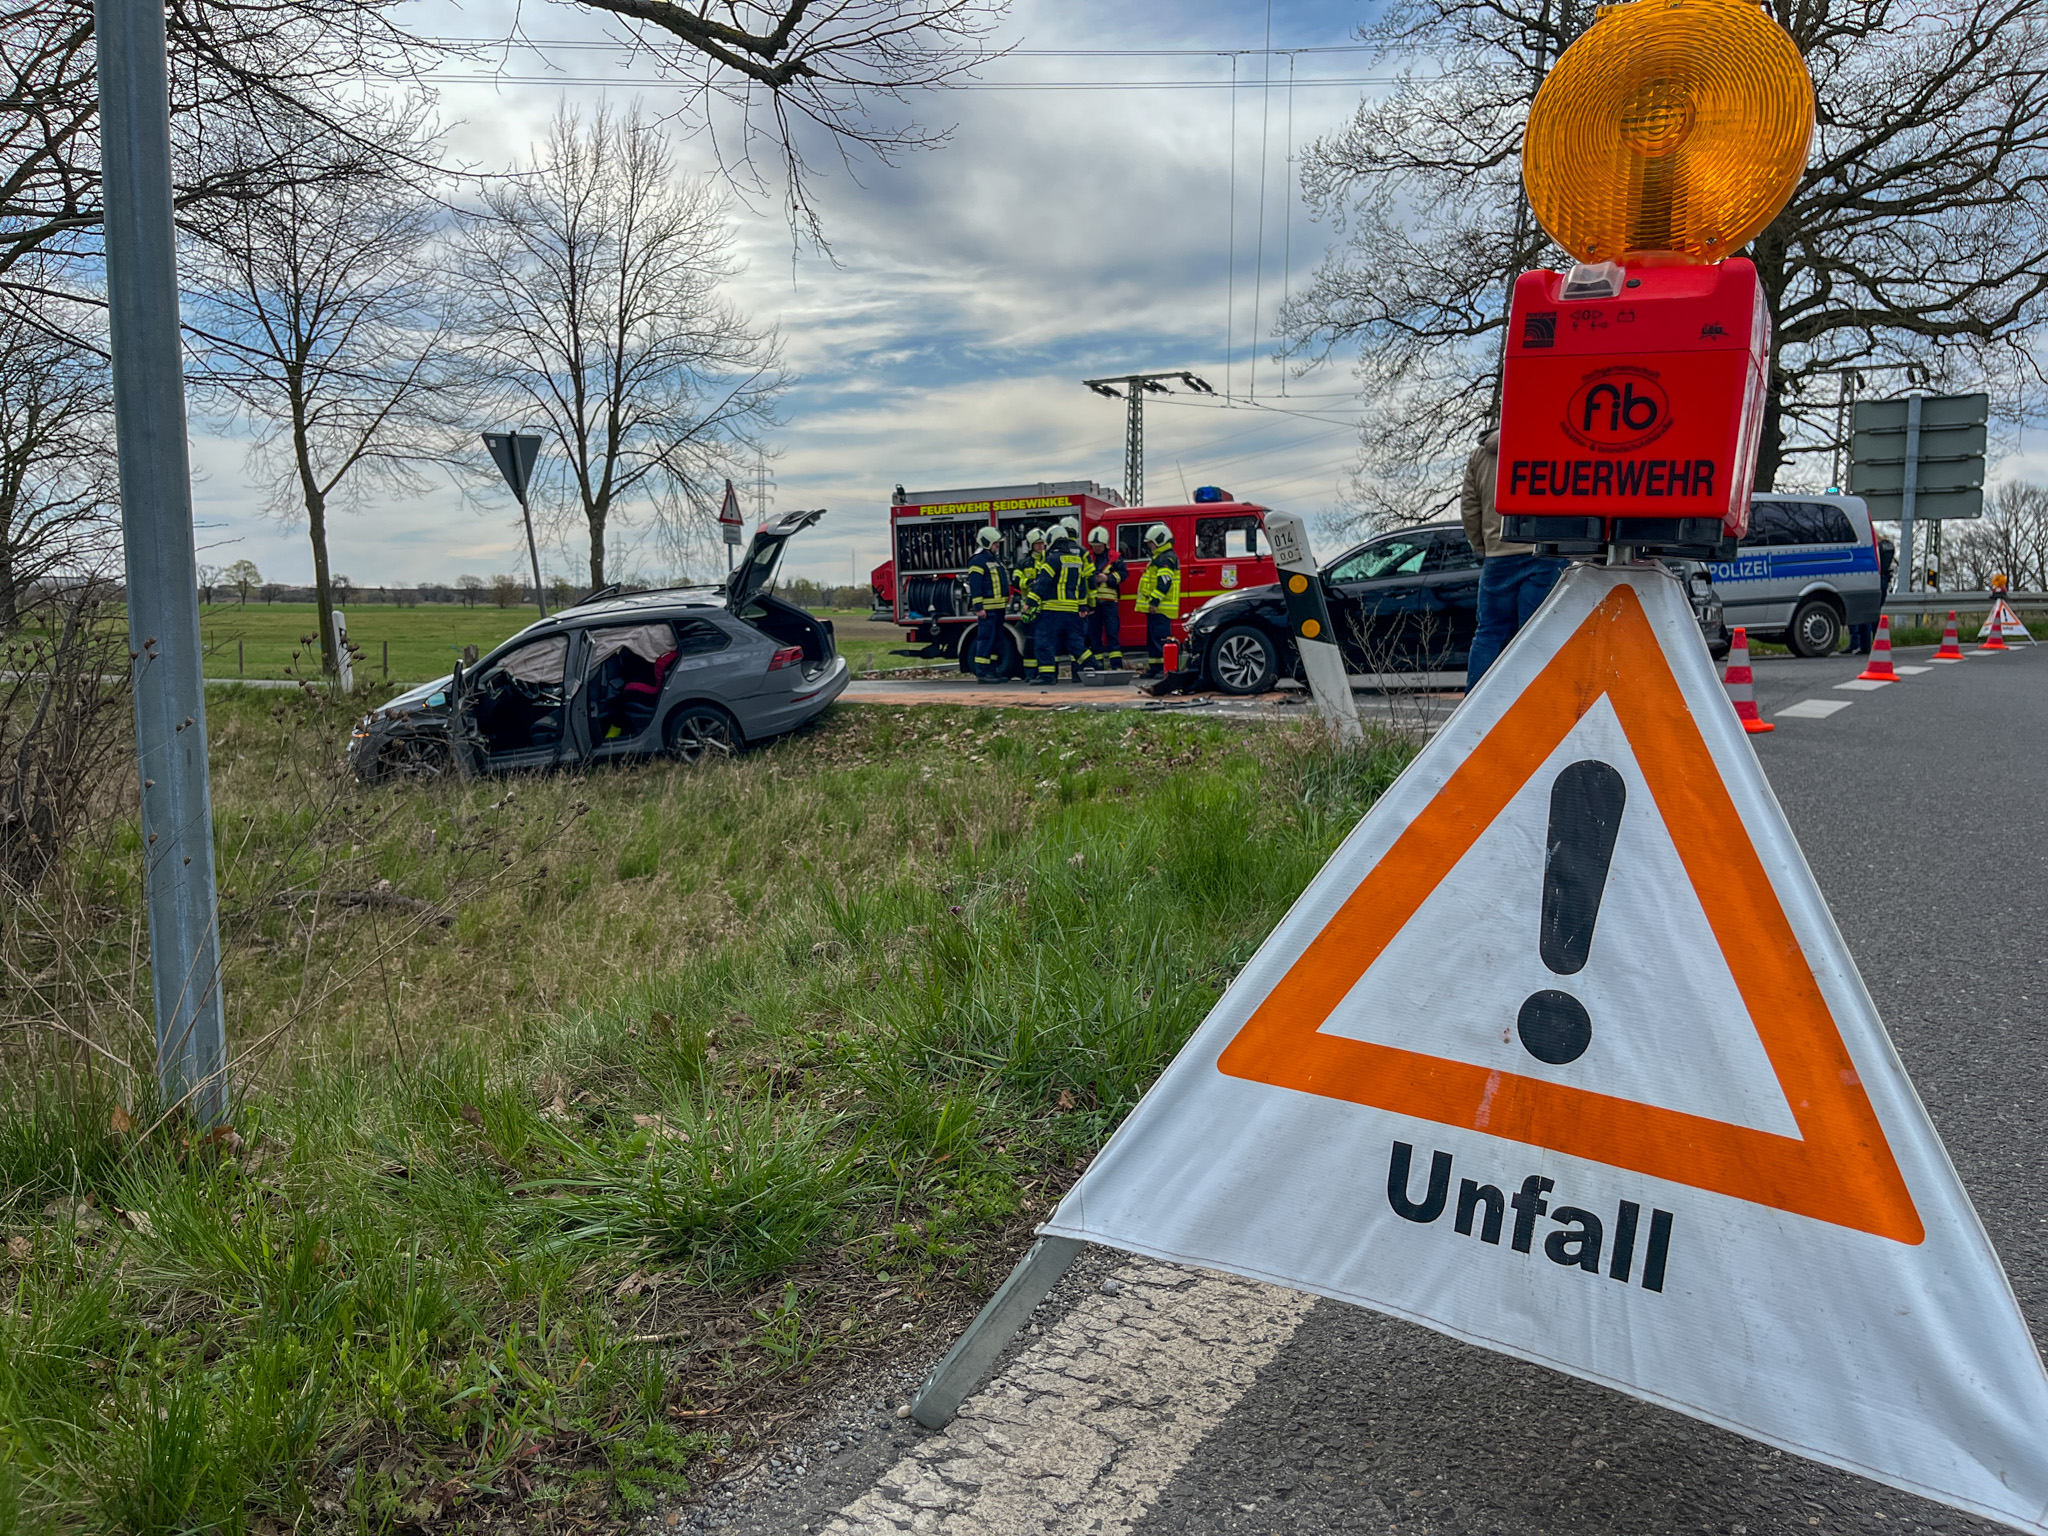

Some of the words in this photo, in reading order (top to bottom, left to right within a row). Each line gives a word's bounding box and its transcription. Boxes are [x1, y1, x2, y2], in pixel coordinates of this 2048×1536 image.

[1510, 459, 1715, 497] FEUERWEHR
[920, 502, 990, 516] FEUERWEHR
[992, 496, 1073, 511] SEIDEWINKEL
[1274, 531, 1294, 547] 014
[1708, 559, 1768, 579] POLIZEI
[1387, 1140, 1674, 1293] Unfall
